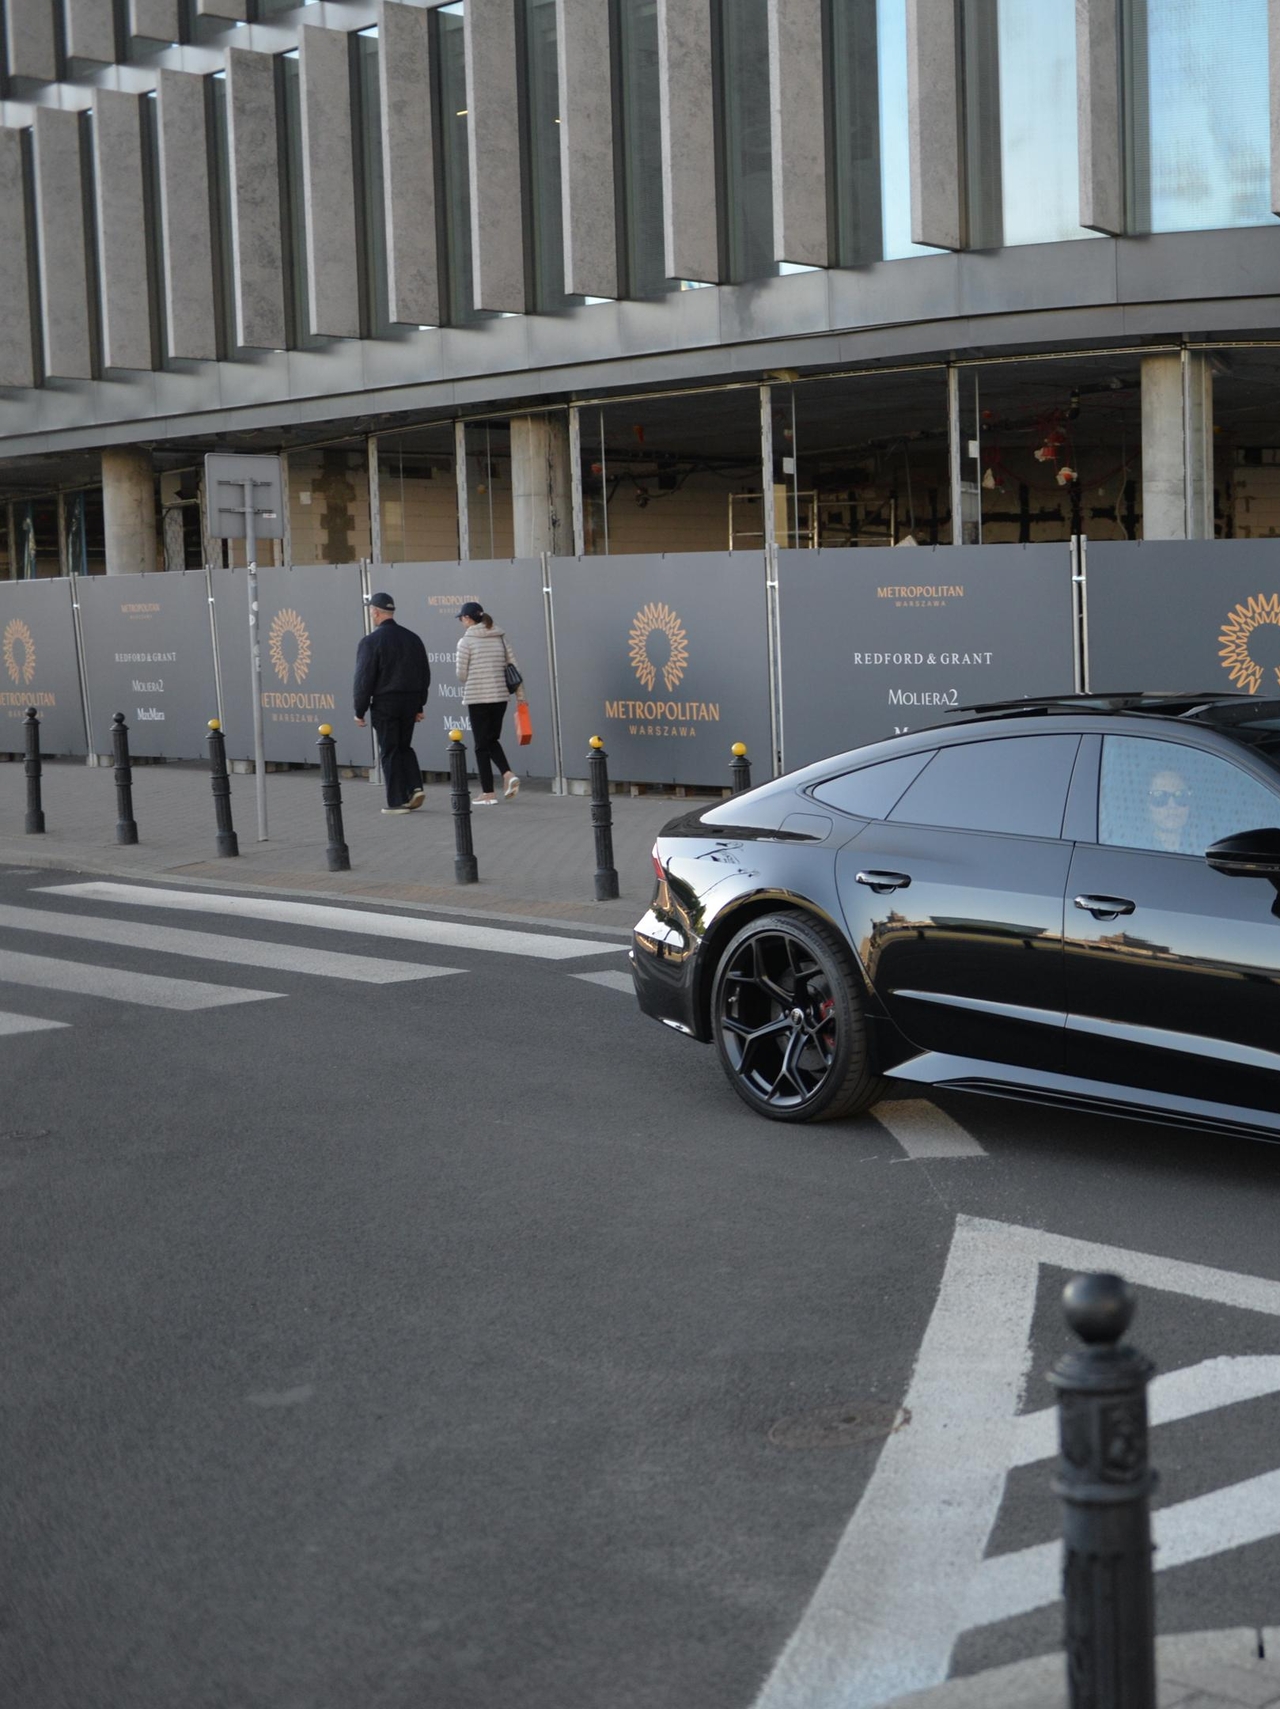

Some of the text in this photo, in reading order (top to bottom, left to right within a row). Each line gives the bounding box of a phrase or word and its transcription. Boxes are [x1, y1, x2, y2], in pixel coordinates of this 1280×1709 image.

[877, 586, 964, 597] METROPOLITAN
[115, 653, 146, 662] REDFORD
[152, 652, 176, 662] GRANT
[854, 652, 993, 665] REDFORD & GRANT
[888, 689, 959, 705] MOLIERA2
[137, 708, 165, 720] MaxMara
[605, 701, 720, 721] METROPOLITAN
[272, 713, 319, 723] WARSZAWA
[629, 725, 696, 736] WARSZAWA
